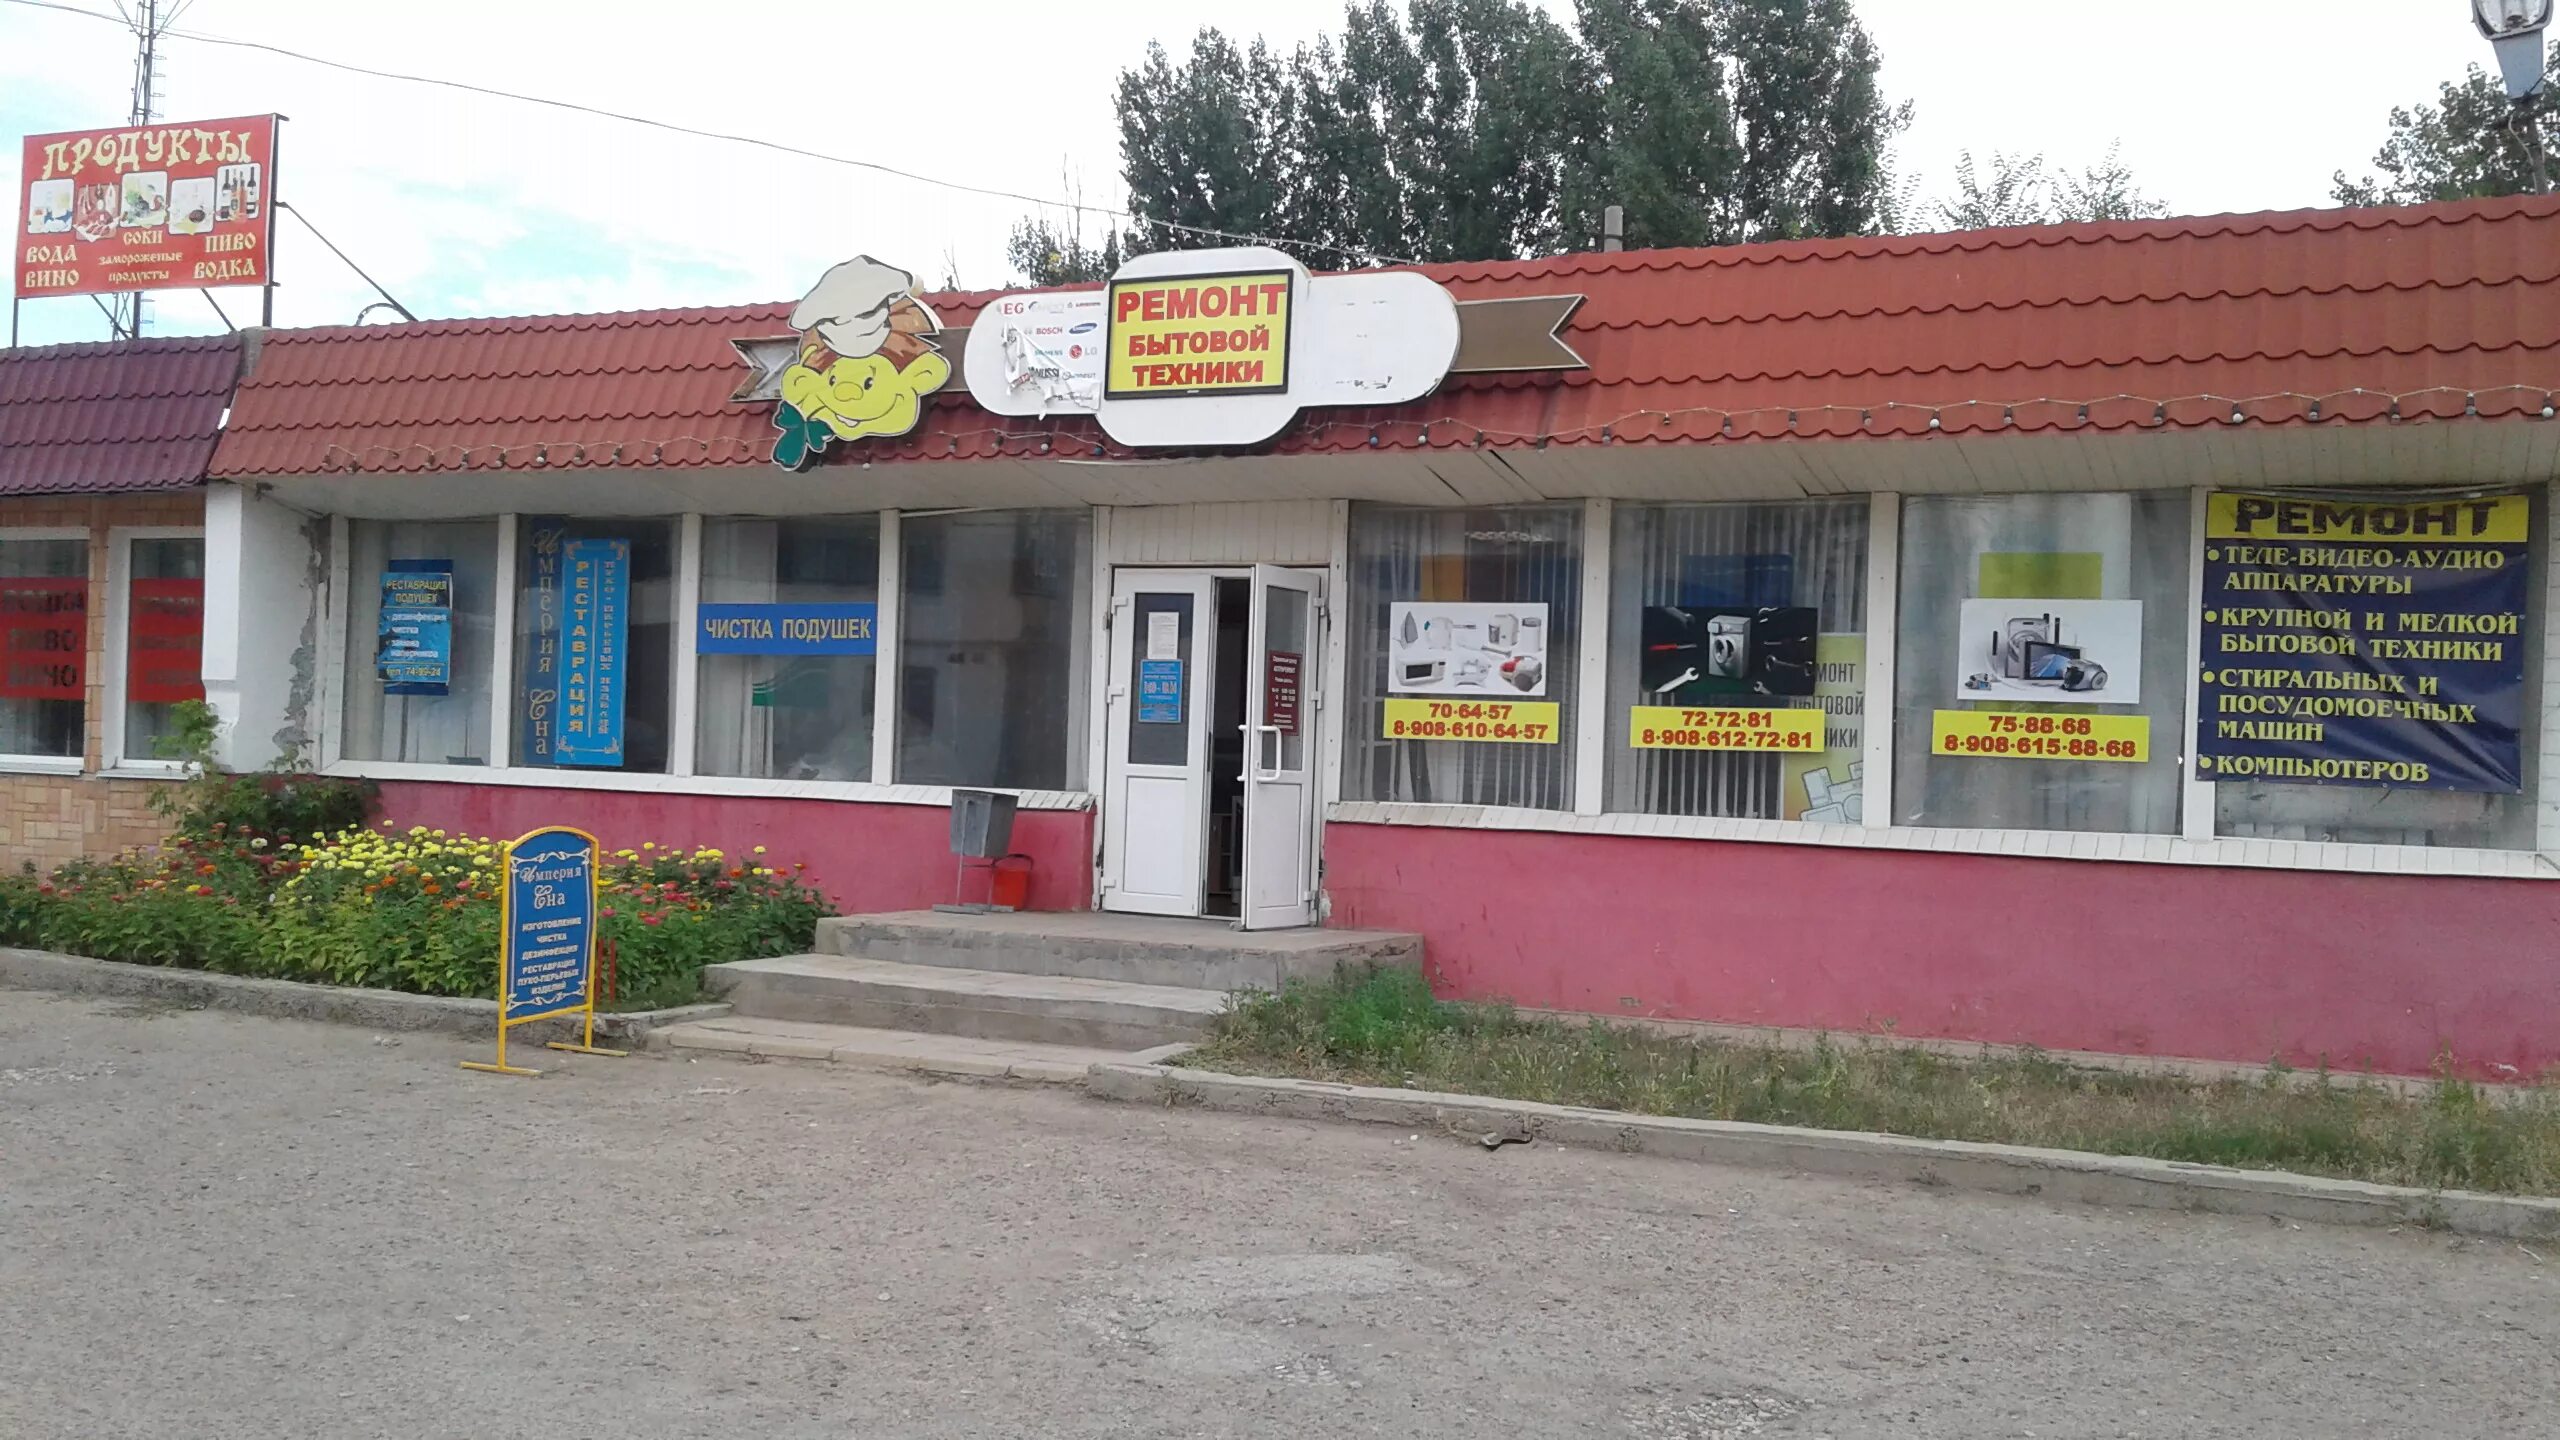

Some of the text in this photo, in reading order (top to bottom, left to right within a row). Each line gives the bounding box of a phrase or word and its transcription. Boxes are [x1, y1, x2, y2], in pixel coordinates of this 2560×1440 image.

[42, 128, 251, 179] ПРОДУКТЫ
[123, 230, 163, 245] СОКИ
[205, 232, 256, 253] ПИВО
[26, 245, 77, 264] ВОДА
[25, 269, 80, 288] ВИНО
[194, 258, 256, 280] ВОДКА
[1117, 284, 1287, 323] РЕМОНТ
[1128, 324, 1270, 357] БЫТОВОЙ
[1132, 360, 1264, 387] ТЕХНИКИ
[2234, 498, 2499, 537] РЕМОНТ
[2223, 545, 2504, 572] ТЕЛЕ-ВИДЕО-АУДИО
[2223, 571, 2412, 595] АППАРАТУРЫ
[705, 619, 871, 643] ЧИСТКА ПОДУШЕК
[2221, 606, 2519, 635] КРУПНОЙ И МЕЛКОЙ
[568, 561, 589, 732] РЕСТАВРАЦИЯ
[2220, 633, 2503, 662] БЫТОВОЙ ТЕХНИКИ
[2219, 668, 2439, 696] СТИРАЛЬНЫХ И
[2218, 694, 2477, 723] ПОСУДОМОЕЧНЫХ
[2217, 720, 2324, 742] МАШИН
[2216, 755, 2429, 782] КОМПЬЮТЕРОВ
[520, 865, 582, 882] Империя
[534, 884, 565, 909] Сна
